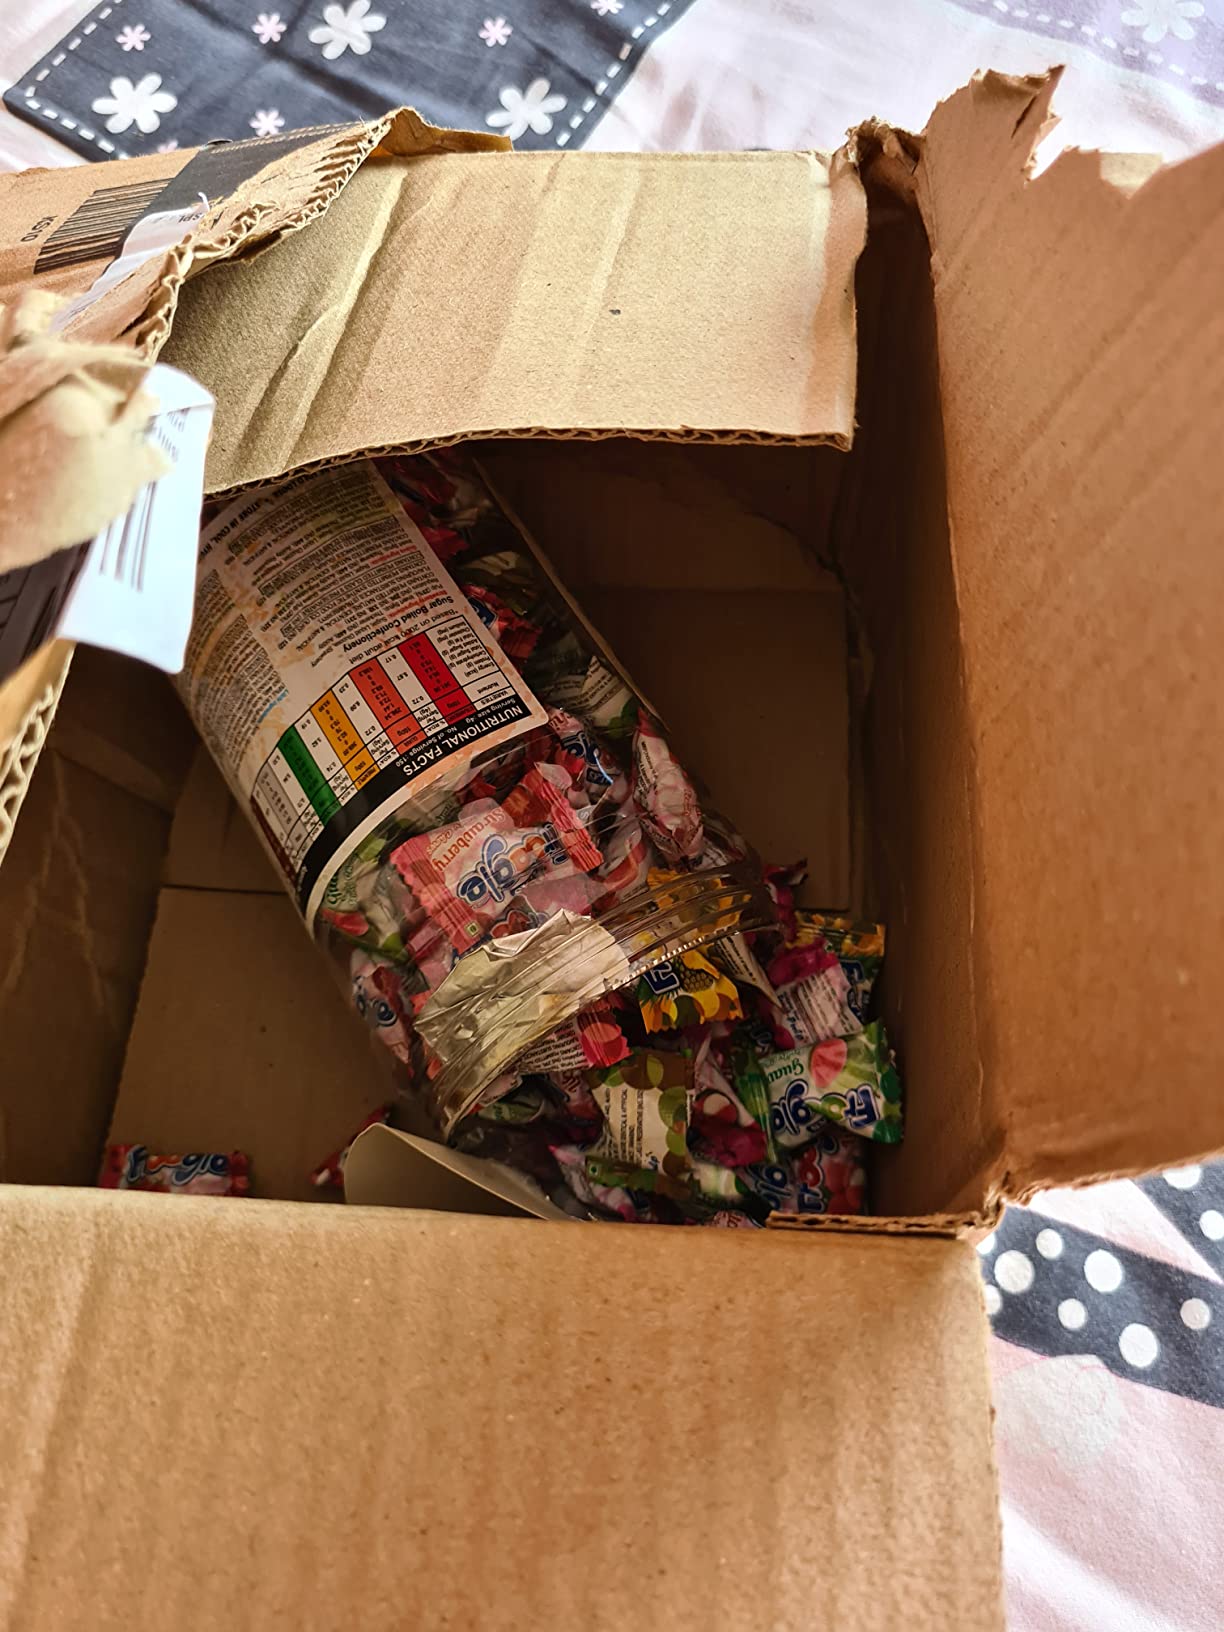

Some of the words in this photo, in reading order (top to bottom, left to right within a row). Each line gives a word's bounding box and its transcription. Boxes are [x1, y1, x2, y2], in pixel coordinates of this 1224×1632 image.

[427, 594, 453, 609] Sugar
[400, 605, 428, 622] Boiled
[399, 623, 419, 637] 2000
[419, 618, 429, 626] on
[341, 618, 400, 653] Confectionery
[383, 634, 400, 646] kcal
[363, 642, 383, 656] adult
[348, 652, 364, 664] diet
[490, 696, 516, 712] Serving
[477, 708, 490, 718] size
[441, 703, 523, 750] NUTRITIONAL
[408, 736, 437, 757] Servings
[401, 744, 442, 777] FACTS
[432, 806, 506, 872] Strawberry
[768, 1058, 804, 1083] Guav
